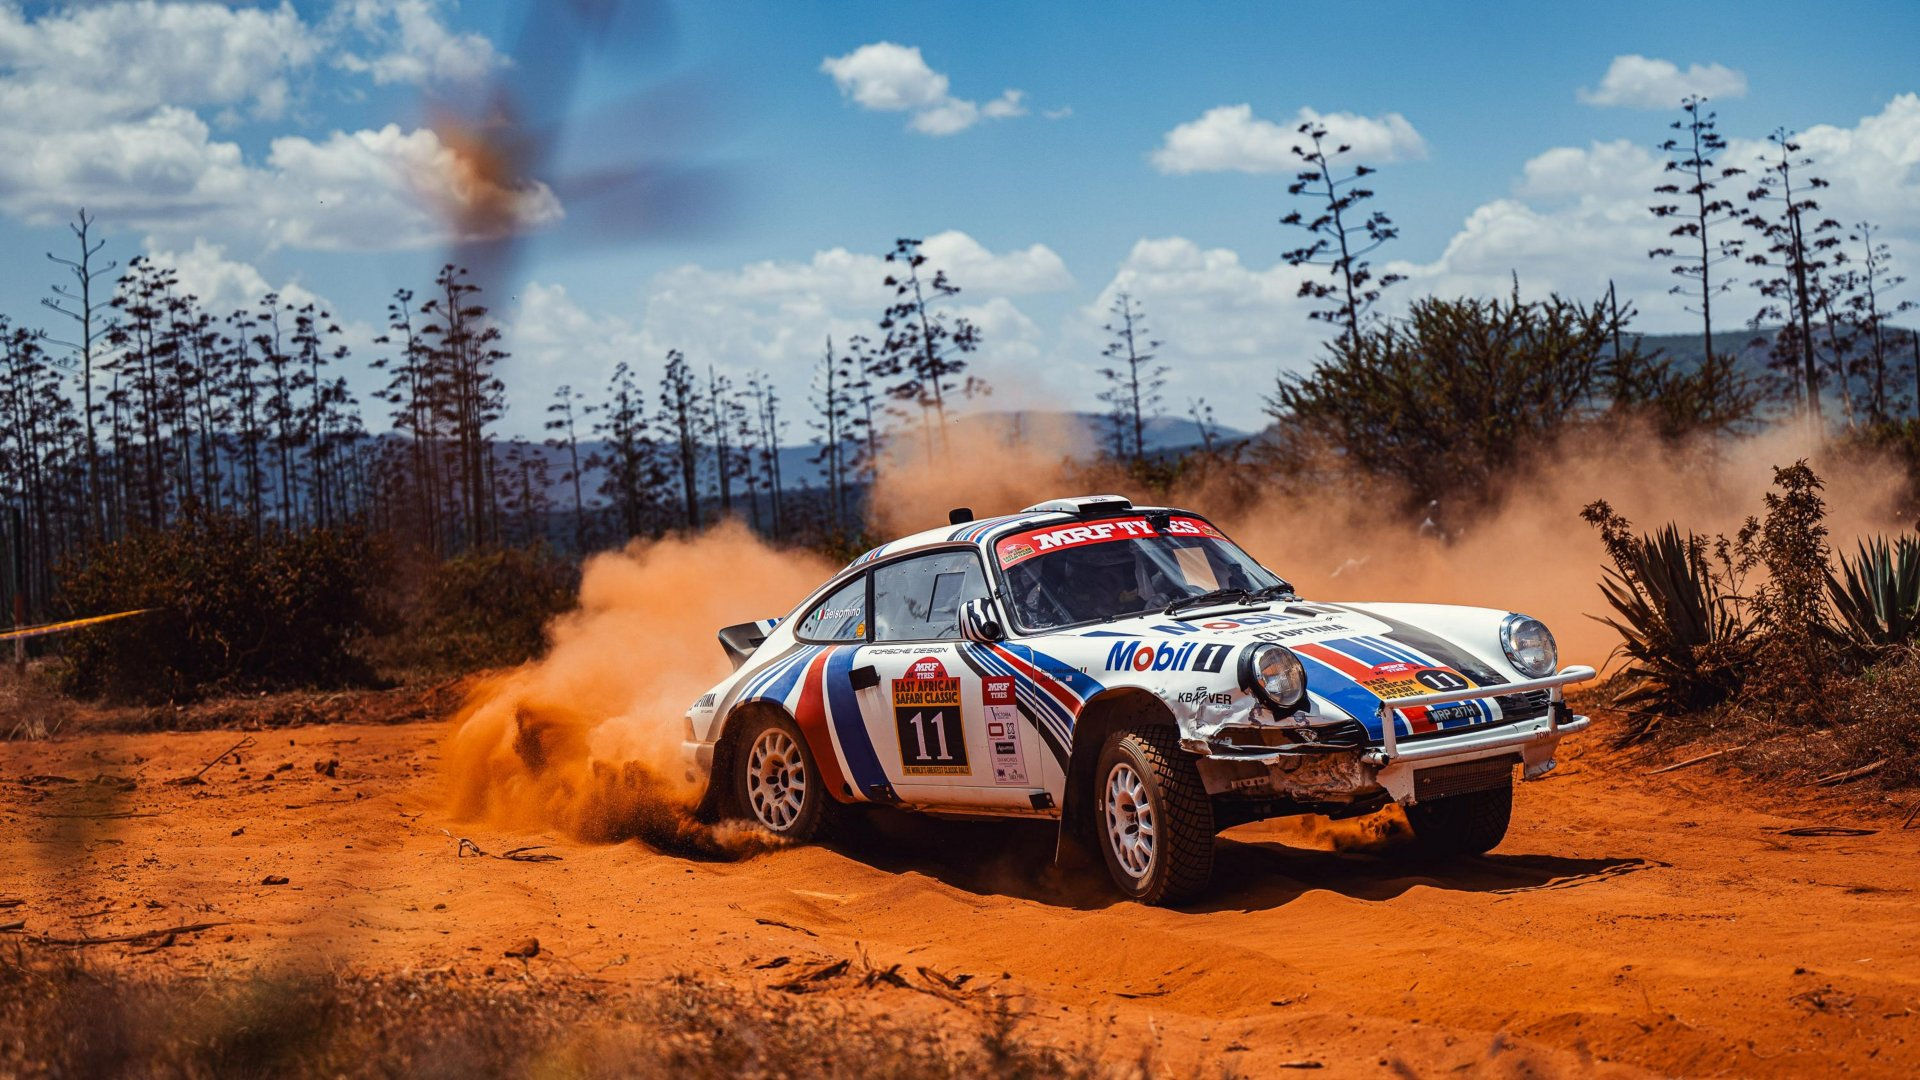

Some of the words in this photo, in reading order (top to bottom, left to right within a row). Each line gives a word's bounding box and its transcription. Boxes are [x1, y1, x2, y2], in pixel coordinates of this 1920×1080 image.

[1032, 522, 1117, 550] MRF
[1117, 520, 1201, 537] TYES
[824, 607, 861, 620] Gelsomino
[1150, 612, 1299, 636] Mobil
[1279, 624, 1349, 637] OPTIMA
[1105, 640, 1198, 672] Mobil
[914, 662, 939, 672] MRF
[916, 672, 935, 680] TYRES
[1423, 672, 1464, 690] 11
[895, 681, 915, 693] EAST
[918, 680, 958, 692] AFRICAN
[988, 682, 1010, 692] MRF
[1373, 679, 1418, 693] AFRICAN
[1378, 686, 1415, 698] SAFARI
[896, 692, 923, 704] SAFARI
[925, 692, 958, 704] CLASSIC
[910, 711, 953, 760] 11
